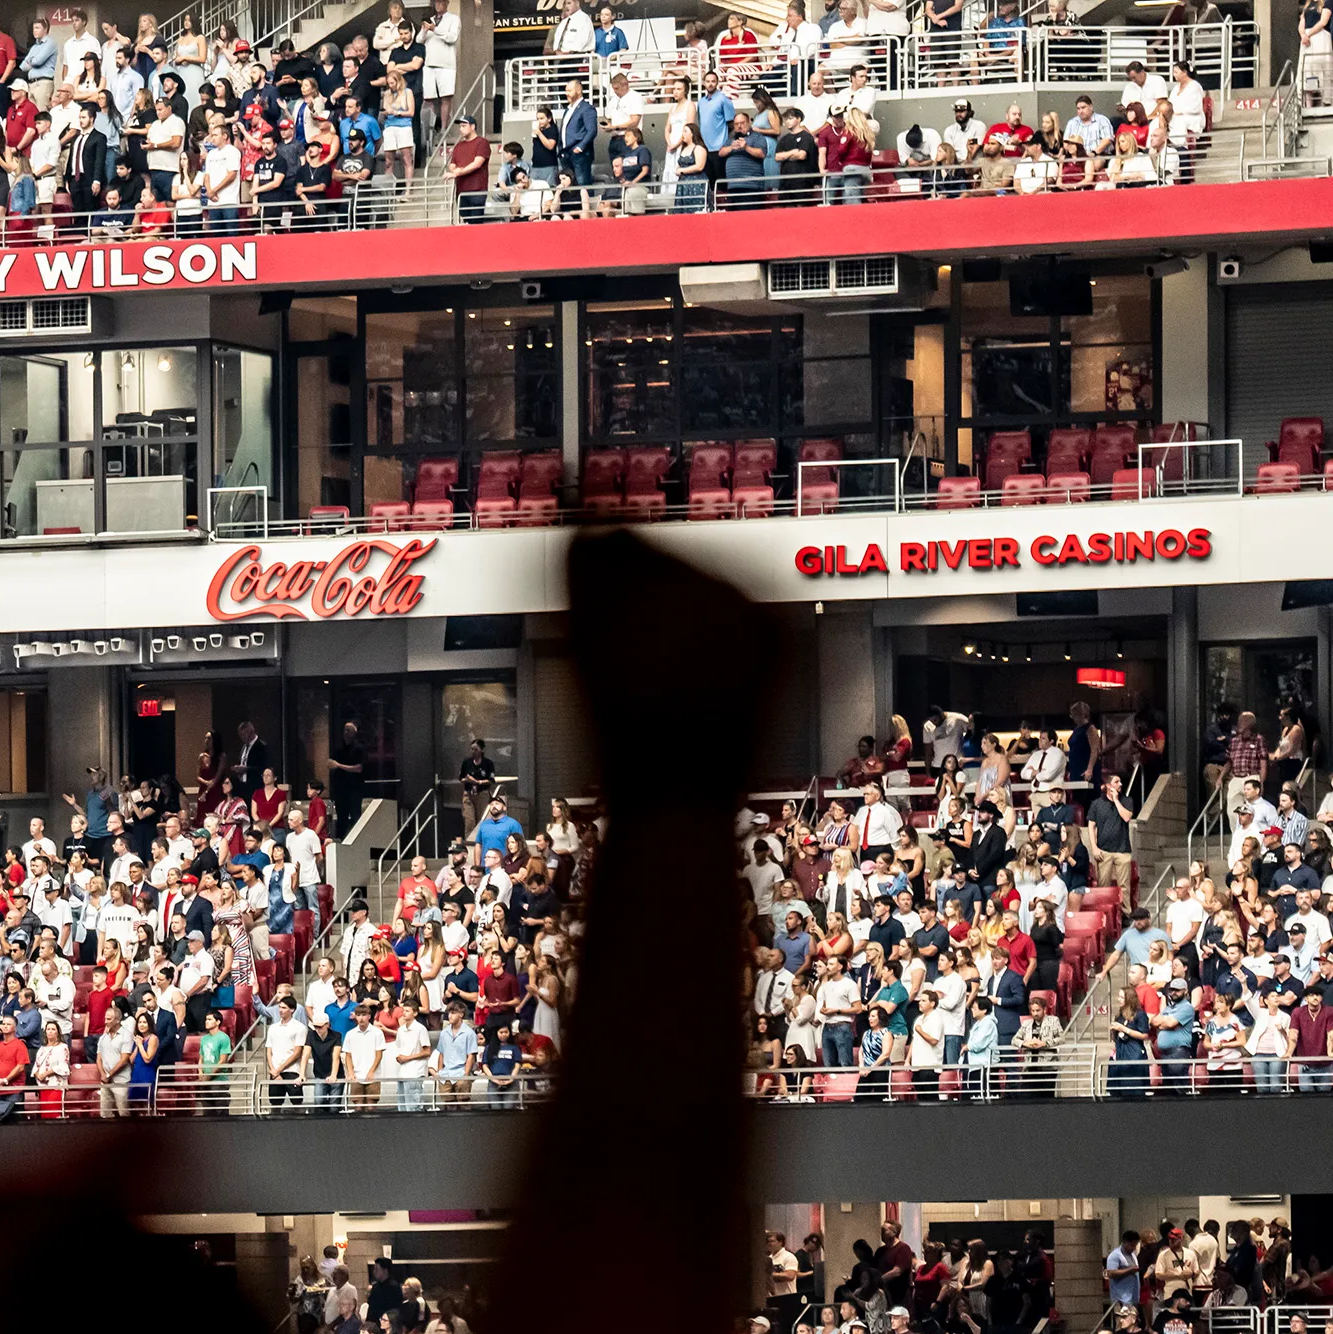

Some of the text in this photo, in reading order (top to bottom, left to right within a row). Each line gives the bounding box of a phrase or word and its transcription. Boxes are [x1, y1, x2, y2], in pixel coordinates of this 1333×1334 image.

[53, 8, 81, 22] 41
[513, 17, 543, 26] STYLE
[1236, 99, 1261, 110] 414
[35, 241, 257, 290] WILSON
[794, 528, 1212, 575] GILA RIVER CASINOS
[206, 538, 439, 621] Coca-Cola
